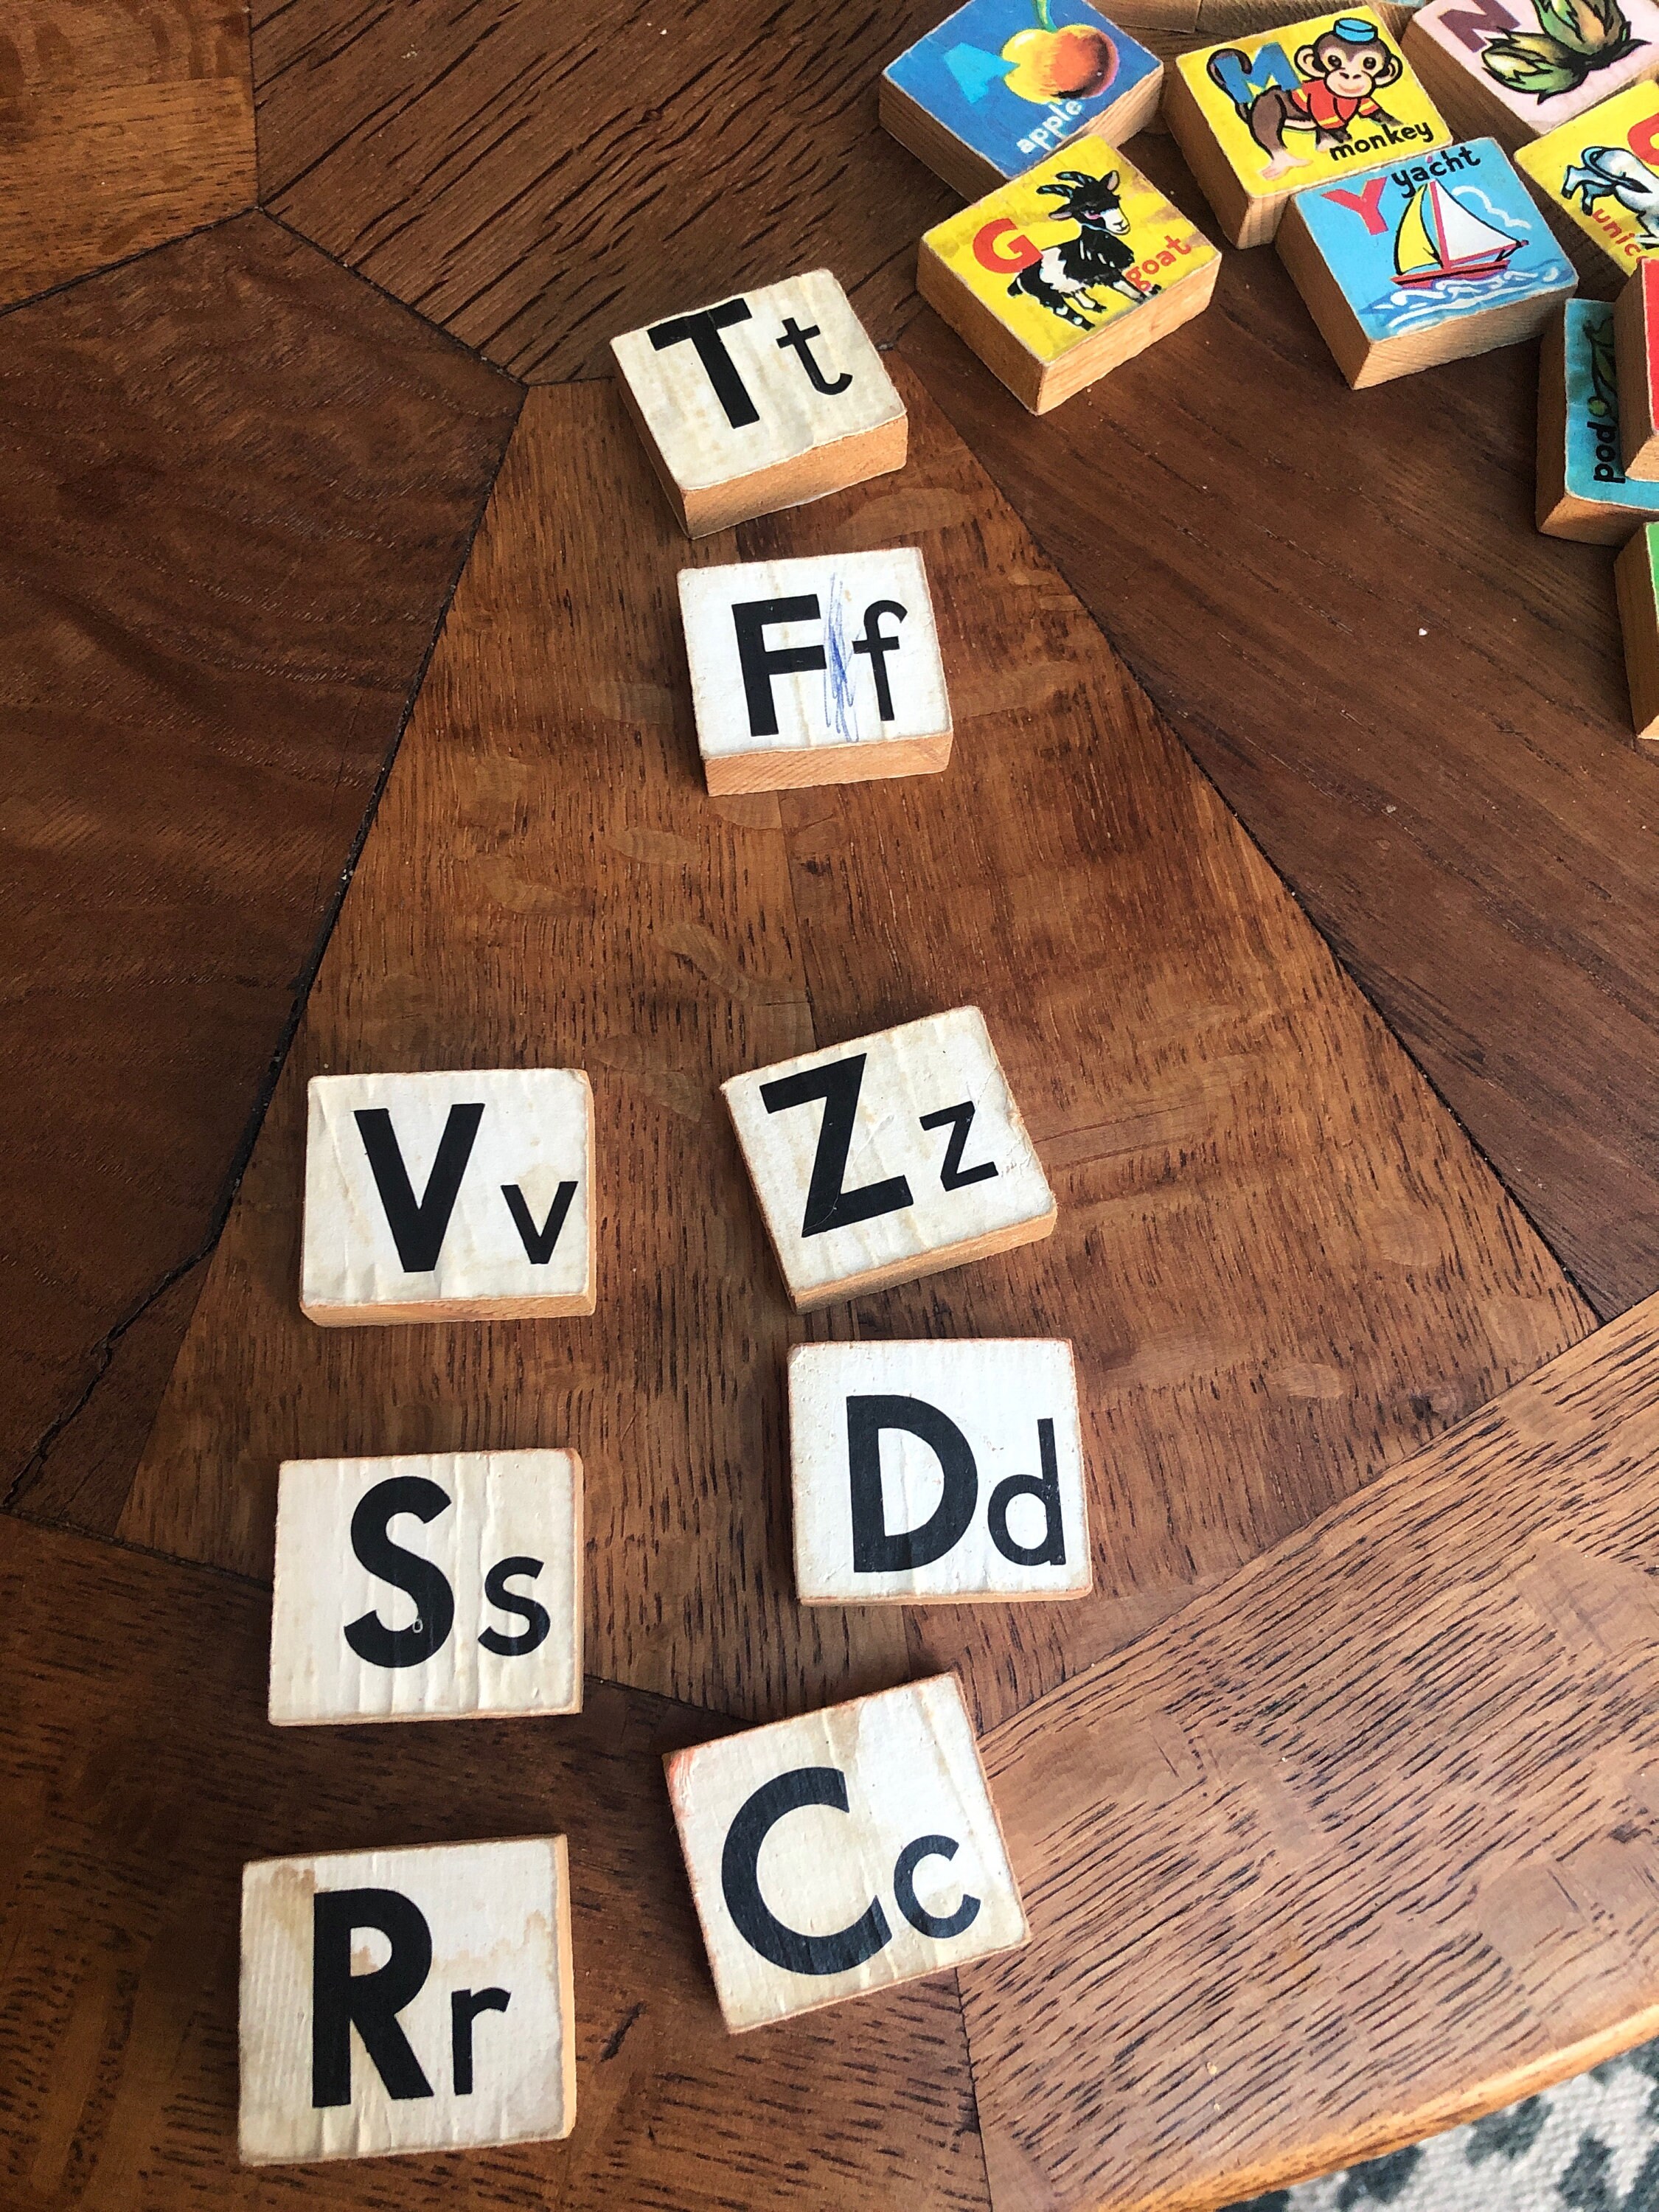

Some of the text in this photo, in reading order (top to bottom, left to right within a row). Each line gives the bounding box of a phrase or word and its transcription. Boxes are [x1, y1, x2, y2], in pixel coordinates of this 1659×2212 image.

[1212, 41, 1304, 104] M
[1015, 97, 1084, 154] apple
[1329, 121, 1435, 161] monkey
[1392, 146, 1481, 199] yacht
[1321, 177, 1389, 236] Y
[973, 218, 1043, 274] G
[1125, 234, 1192, 293] goat
[1592, 208, 1649, 263] unic
[1586, 420, 1627, 484] pod
